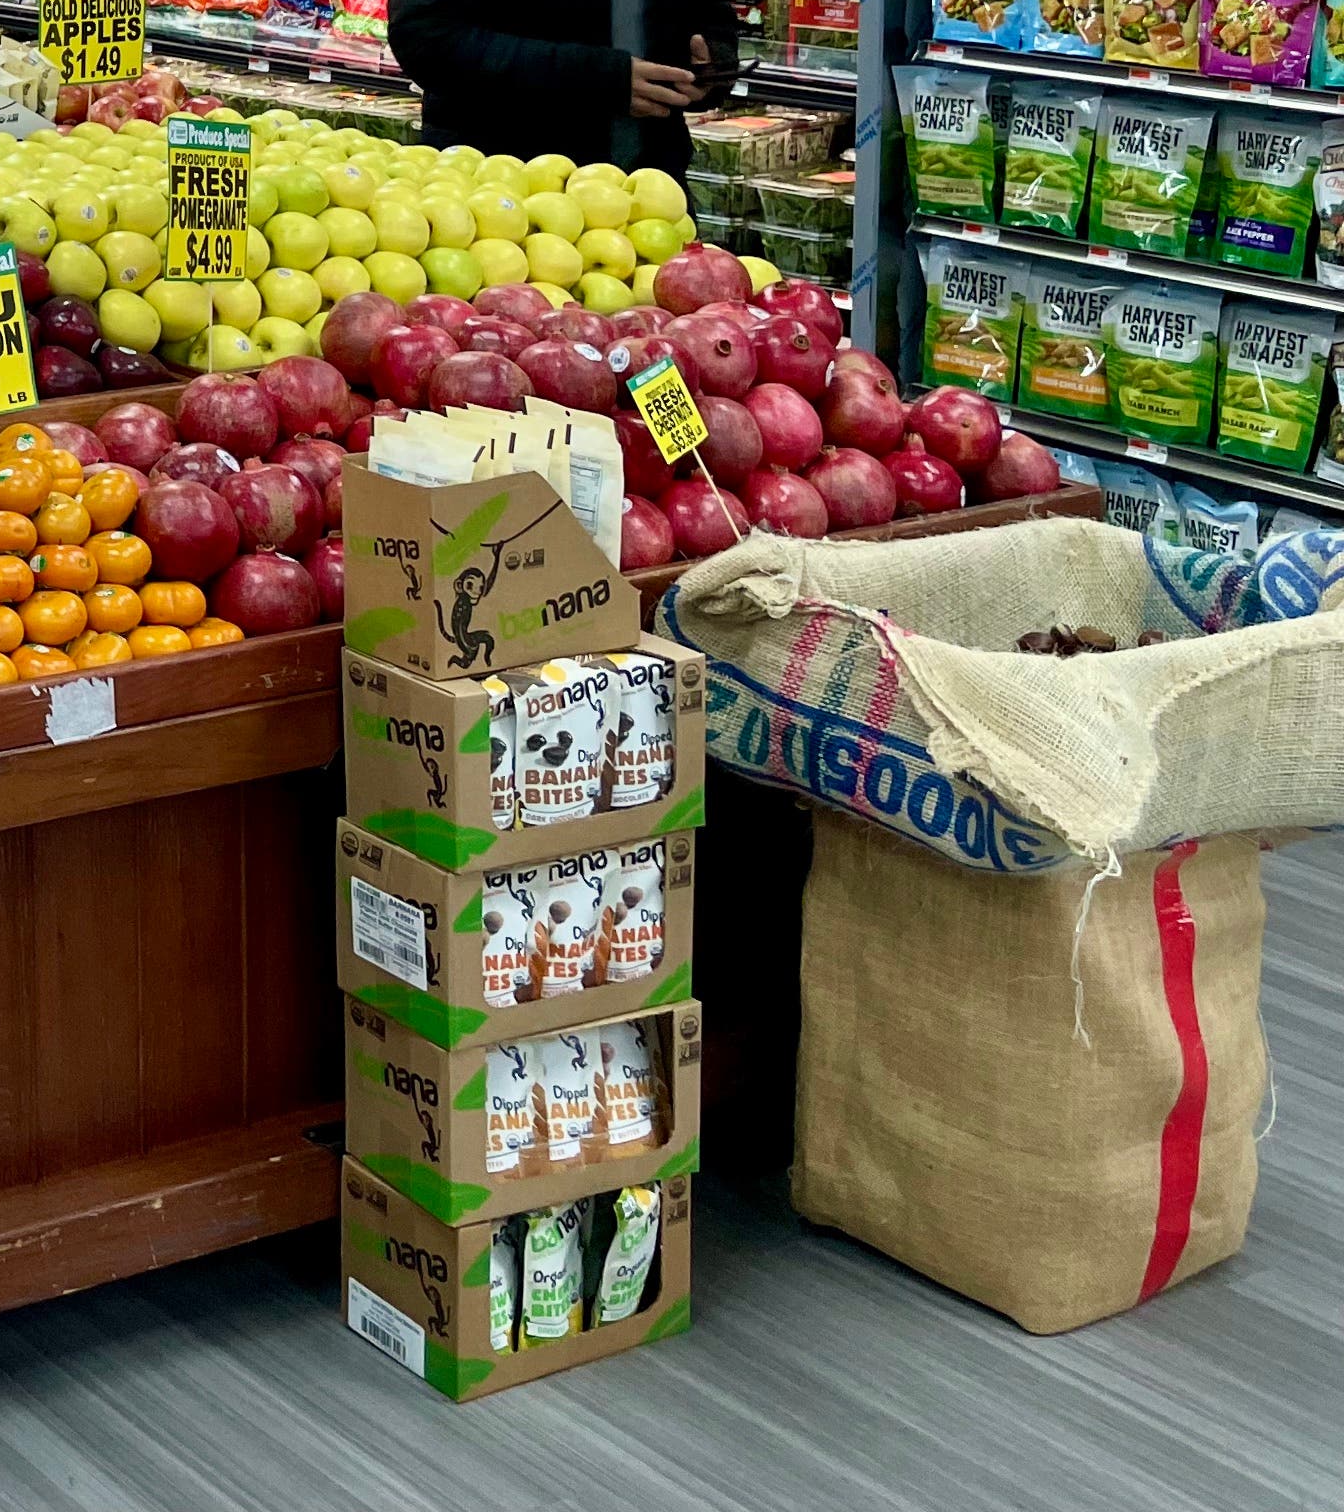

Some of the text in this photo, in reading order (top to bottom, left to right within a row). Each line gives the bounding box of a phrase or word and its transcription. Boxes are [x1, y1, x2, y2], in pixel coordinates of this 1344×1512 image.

[43, 0, 78, 22] GOLD
[42, 17, 142, 48] APPLES
[60, 45, 121, 84] $1.49
[914, 94, 975, 117] HARVEST
[1012, 100, 1074, 130] HARVEST
[920, 112, 964, 132] SNAPS
[1013, 118, 1065, 143] SNAPS
[1112, 114, 1183, 148] HARVEST
[189, 125, 250, 149] Produce Special
[1117, 137, 1170, 161] SNAPS
[1245, 149, 1286, 172] SNAPS
[171, 166, 247, 198] FRESH
[171, 199, 246, 230] POMEGRANATE
[1243, 230, 1274, 242] PEPPER
[185, 231, 232, 278] $4.99
[943, 263, 1007, 295] HARVEST
[945, 284, 997, 307] SNAPS
[1122, 303, 1197, 332] HARVEST
[1129, 326, 1184, 350] SNAPS
[1234, 319, 1309, 355] HARVEST
[1239, 341, 1295, 369] SNAPS
[8, 392, 27, 404] LB
[645, 383, 685, 421] FRESH
[1106, 490, 1159, 522] HARVEST
[1184, 518, 1239, 551] HARVEST
[641, 729, 672, 746] Dipped
[525, 786, 583, 804] BITES
[553, 1084, 589, 1106] Dipped
